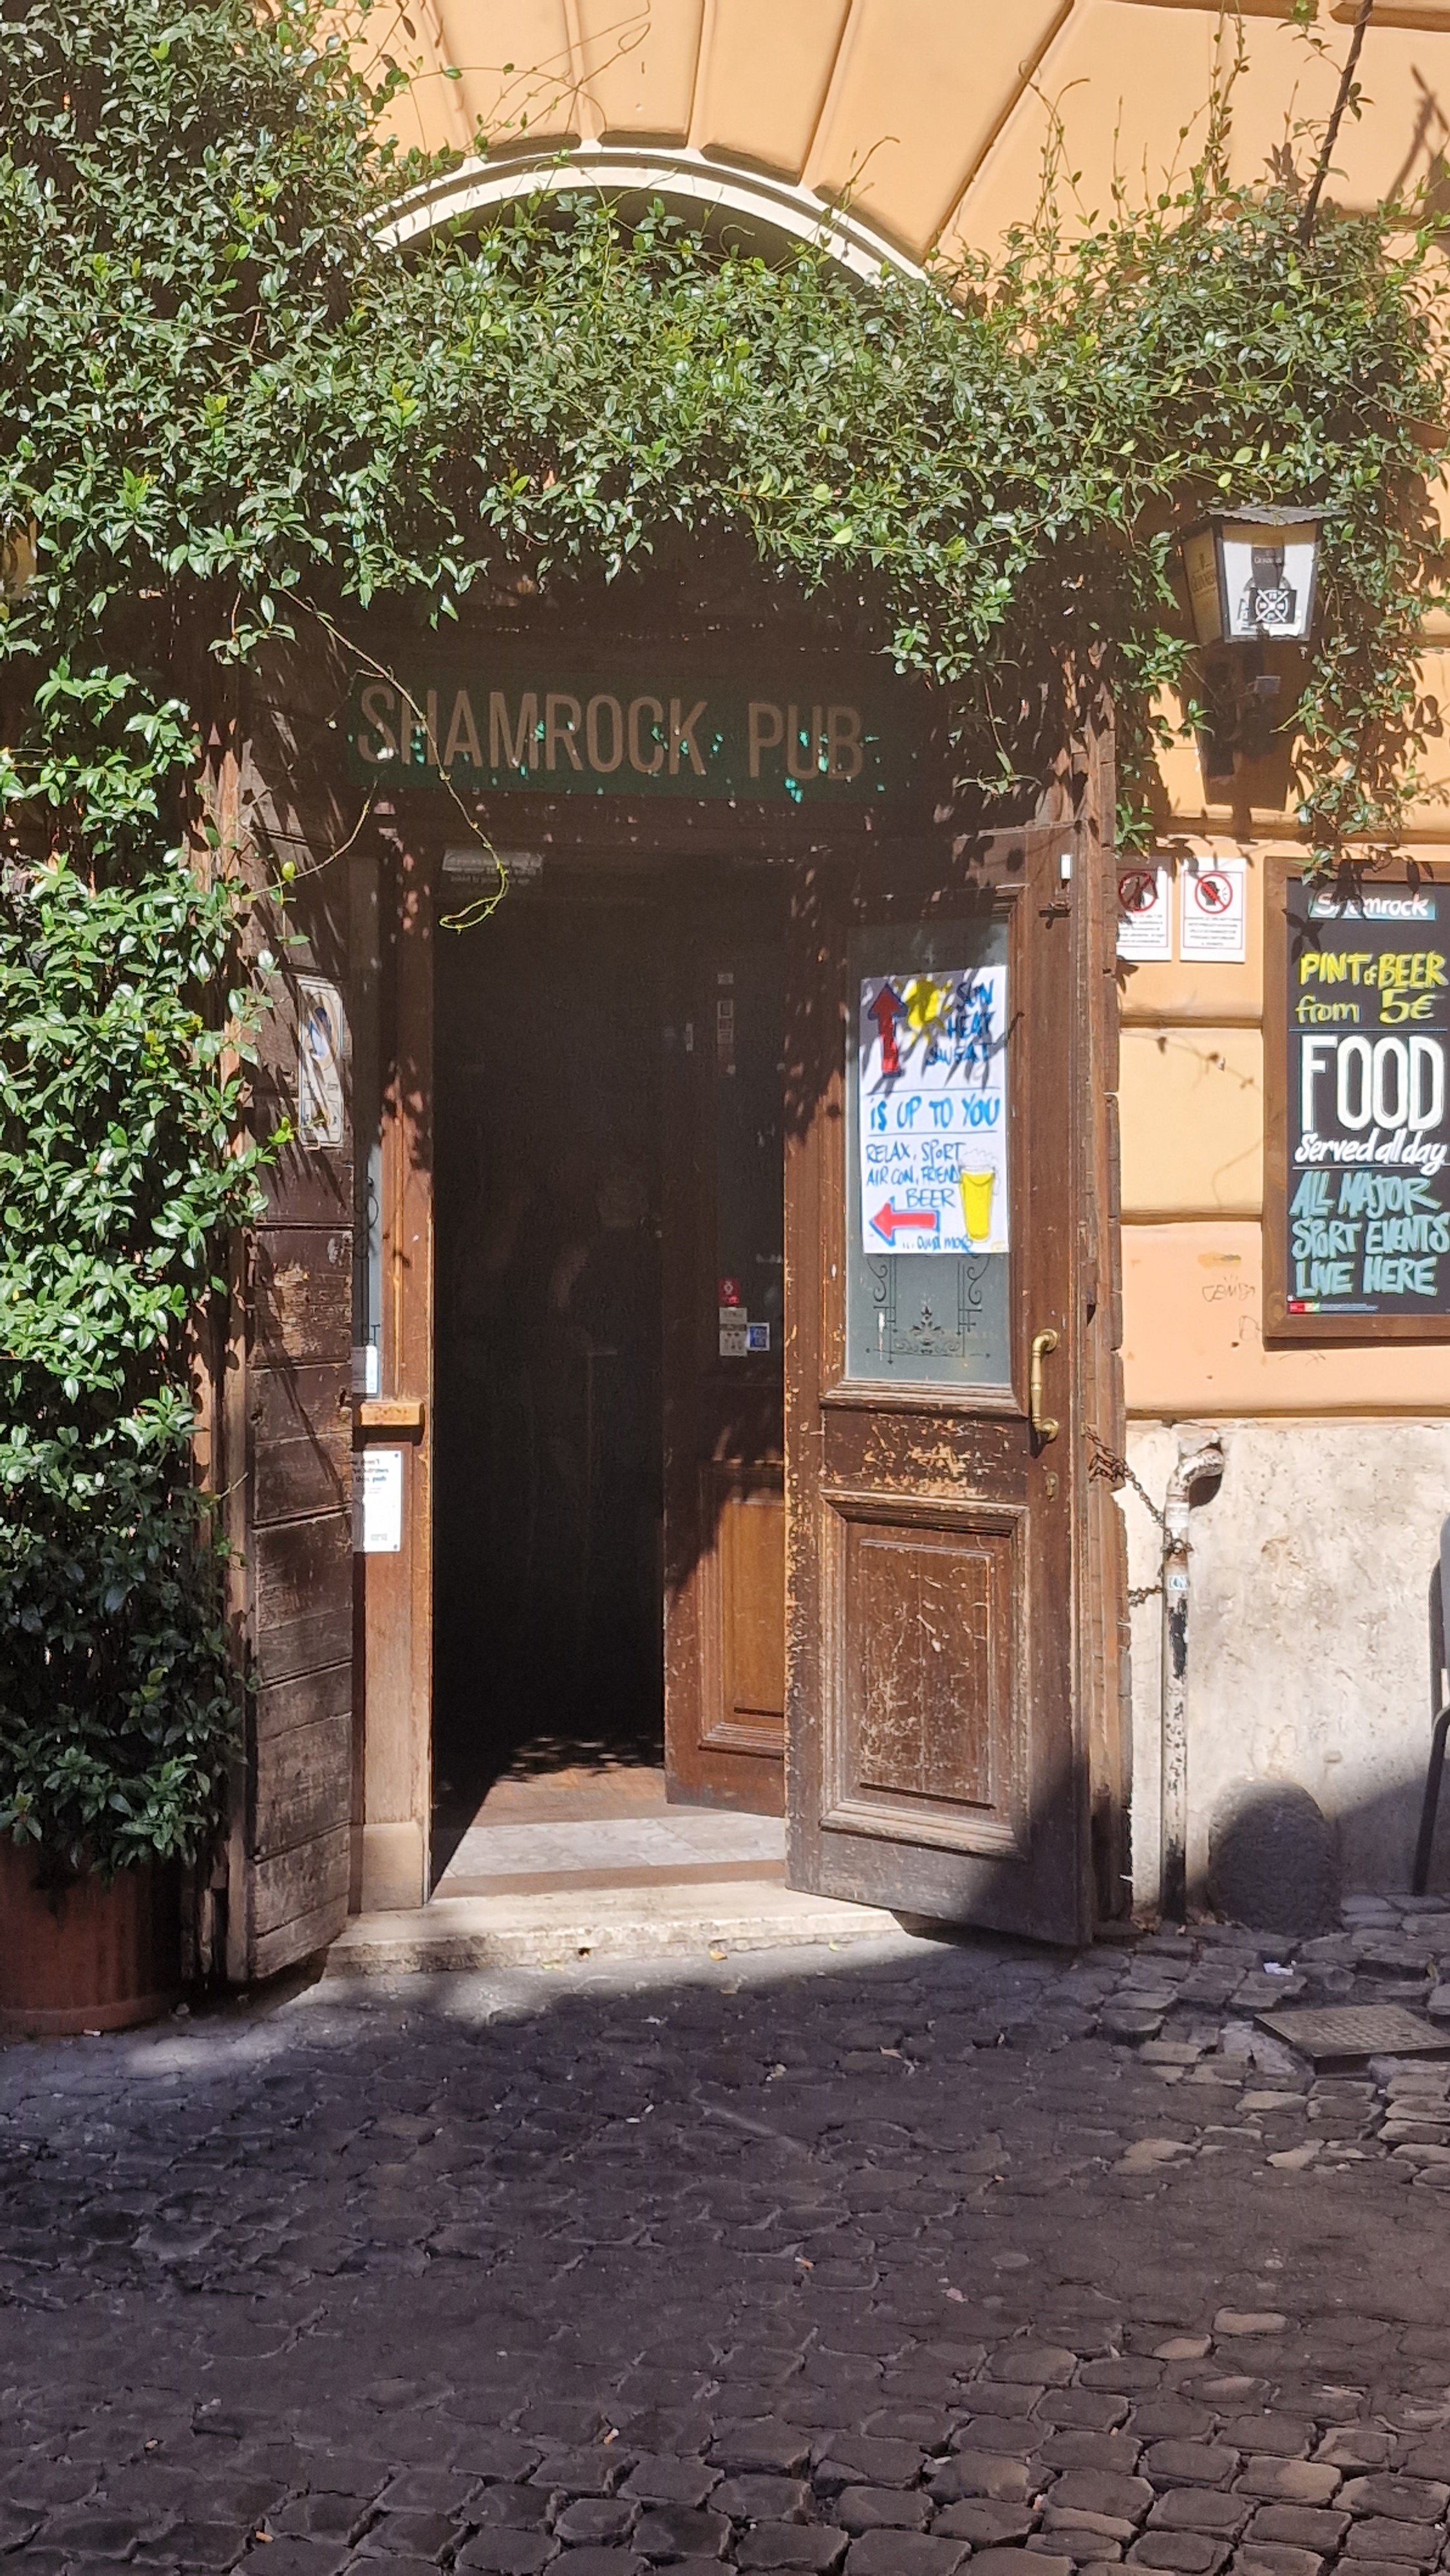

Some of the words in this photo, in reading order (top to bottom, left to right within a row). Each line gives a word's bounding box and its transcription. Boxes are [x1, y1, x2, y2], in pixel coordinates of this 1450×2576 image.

[357, 684, 709, 777] SHAMROCK
[748, 702, 863, 781] PUB
[1299, 951, 1373, 985] PINT
[1377, 951, 1449, 990] BEER
[947, 1010, 997, 1040] HEAT
[1295, 994, 1361, 1023] from
[1379, 988, 1438, 1023] 5€
[1301, 1035, 1444, 1133] FOOD
[897, 1095, 922, 1129] UP
[928, 1097, 954, 1129] TO
[961, 1093, 1001, 1127] YOU
[921, 1139, 966, 1168] SPORT
[1294, 1128, 1380, 1162] Served
[1375, 1128, 1408, 1165] all
[1401, 1130, 1448, 1177] day
[867, 1166, 889, 1187] AIR
[1288, 1170, 1335, 1218] ALL
[1337, 1170, 1442, 1219] MAJOR
[906, 1188, 956, 1208] BEER
[1292, 1217, 1362, 1260] SPORT
[1364, 1211, 1450, 1255] EVENTS
[1295, 1260, 1355, 1298] LIVE
[1362, 1255, 1438, 1296] HERE
